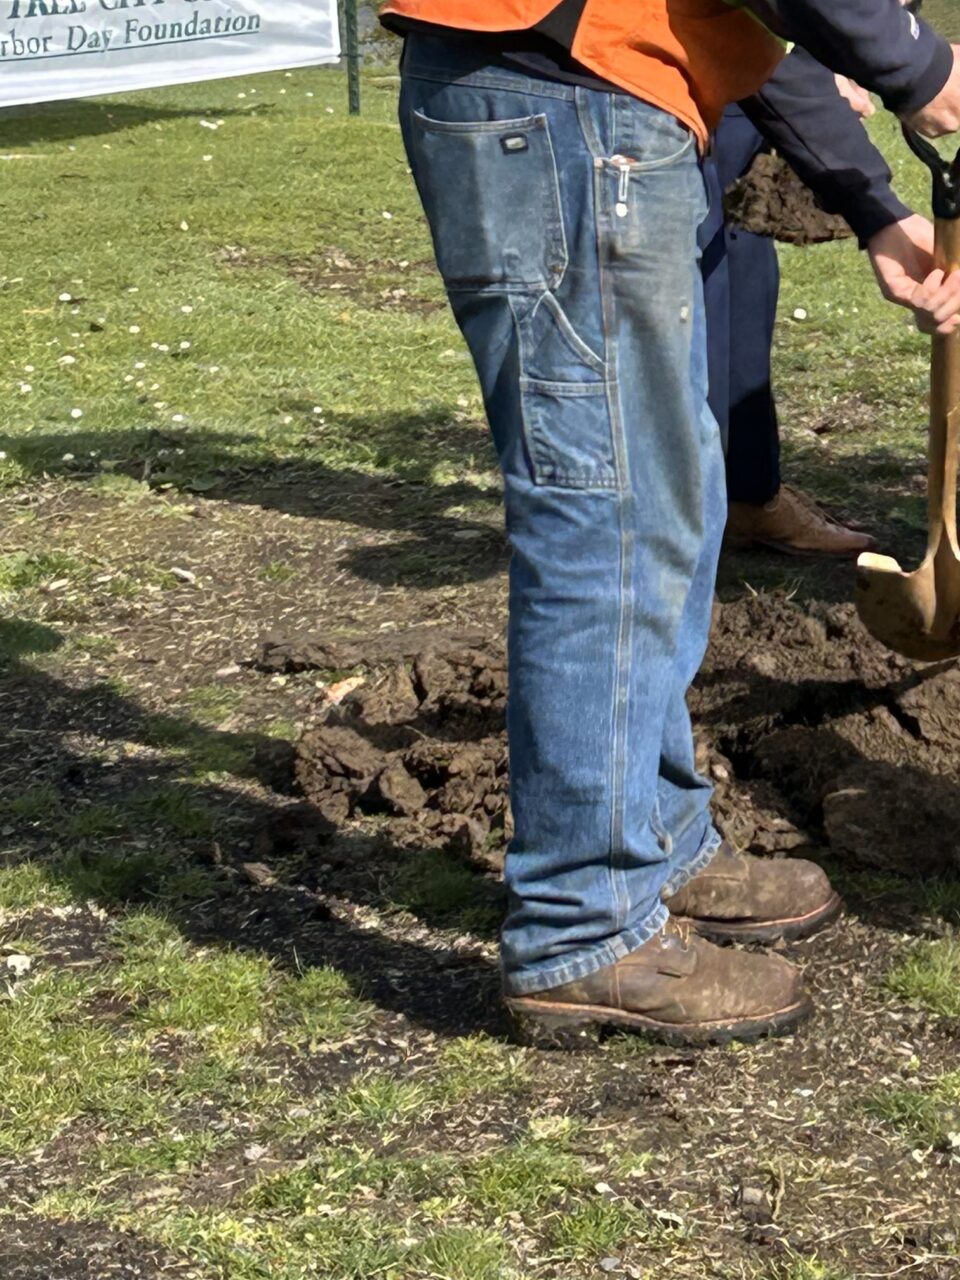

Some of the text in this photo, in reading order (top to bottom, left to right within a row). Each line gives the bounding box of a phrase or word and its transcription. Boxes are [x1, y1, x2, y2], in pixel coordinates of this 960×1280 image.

[0, 10, 260, 56] rbor Day Foundation
